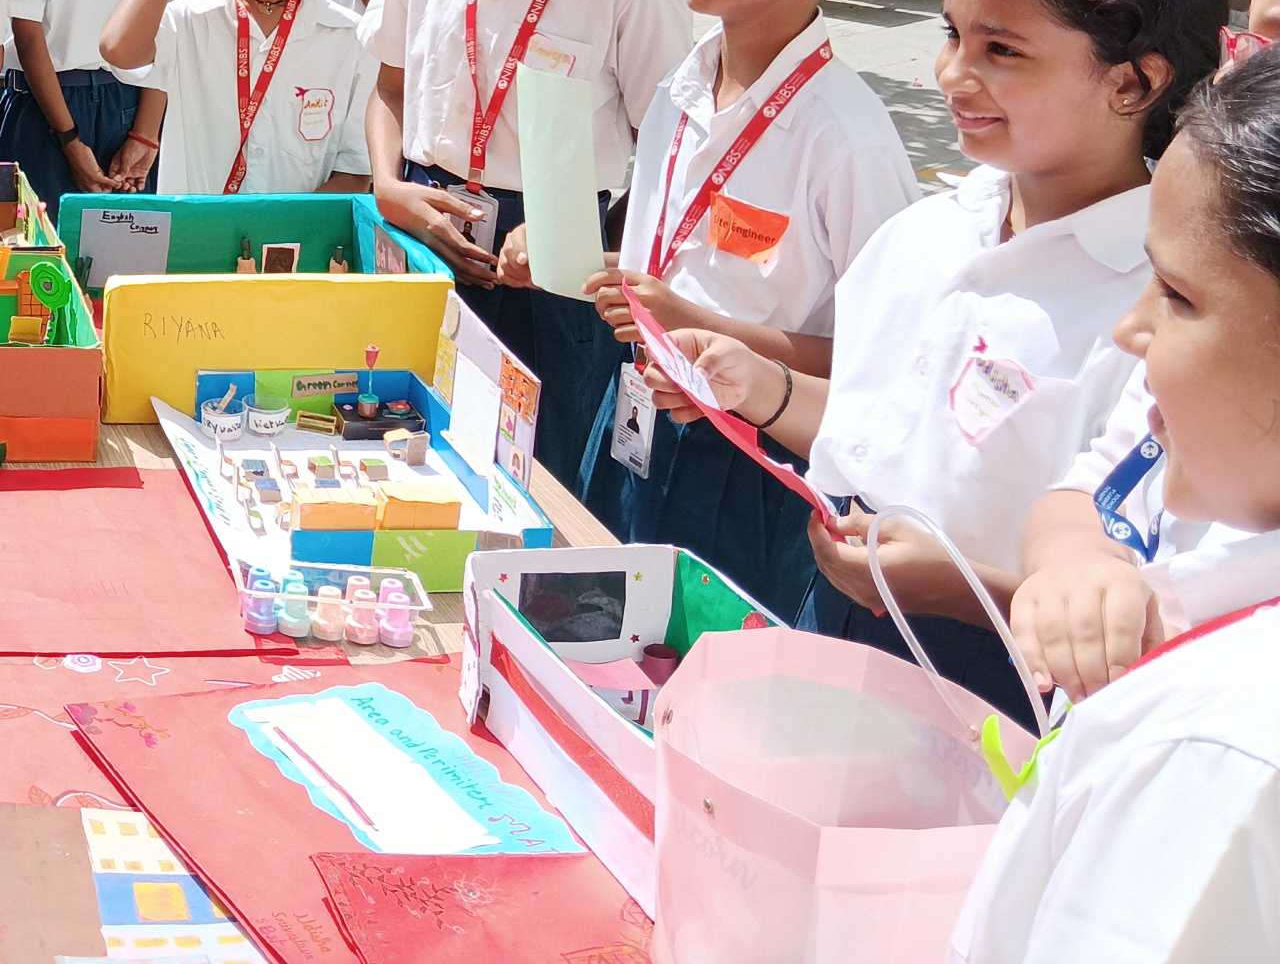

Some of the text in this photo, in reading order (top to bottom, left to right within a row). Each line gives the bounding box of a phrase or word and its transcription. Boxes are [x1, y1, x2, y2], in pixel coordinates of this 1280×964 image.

[144, 313, 224, 345] RIYANA
[351, 696, 389, 726] Area
[390, 728, 421, 750] and
